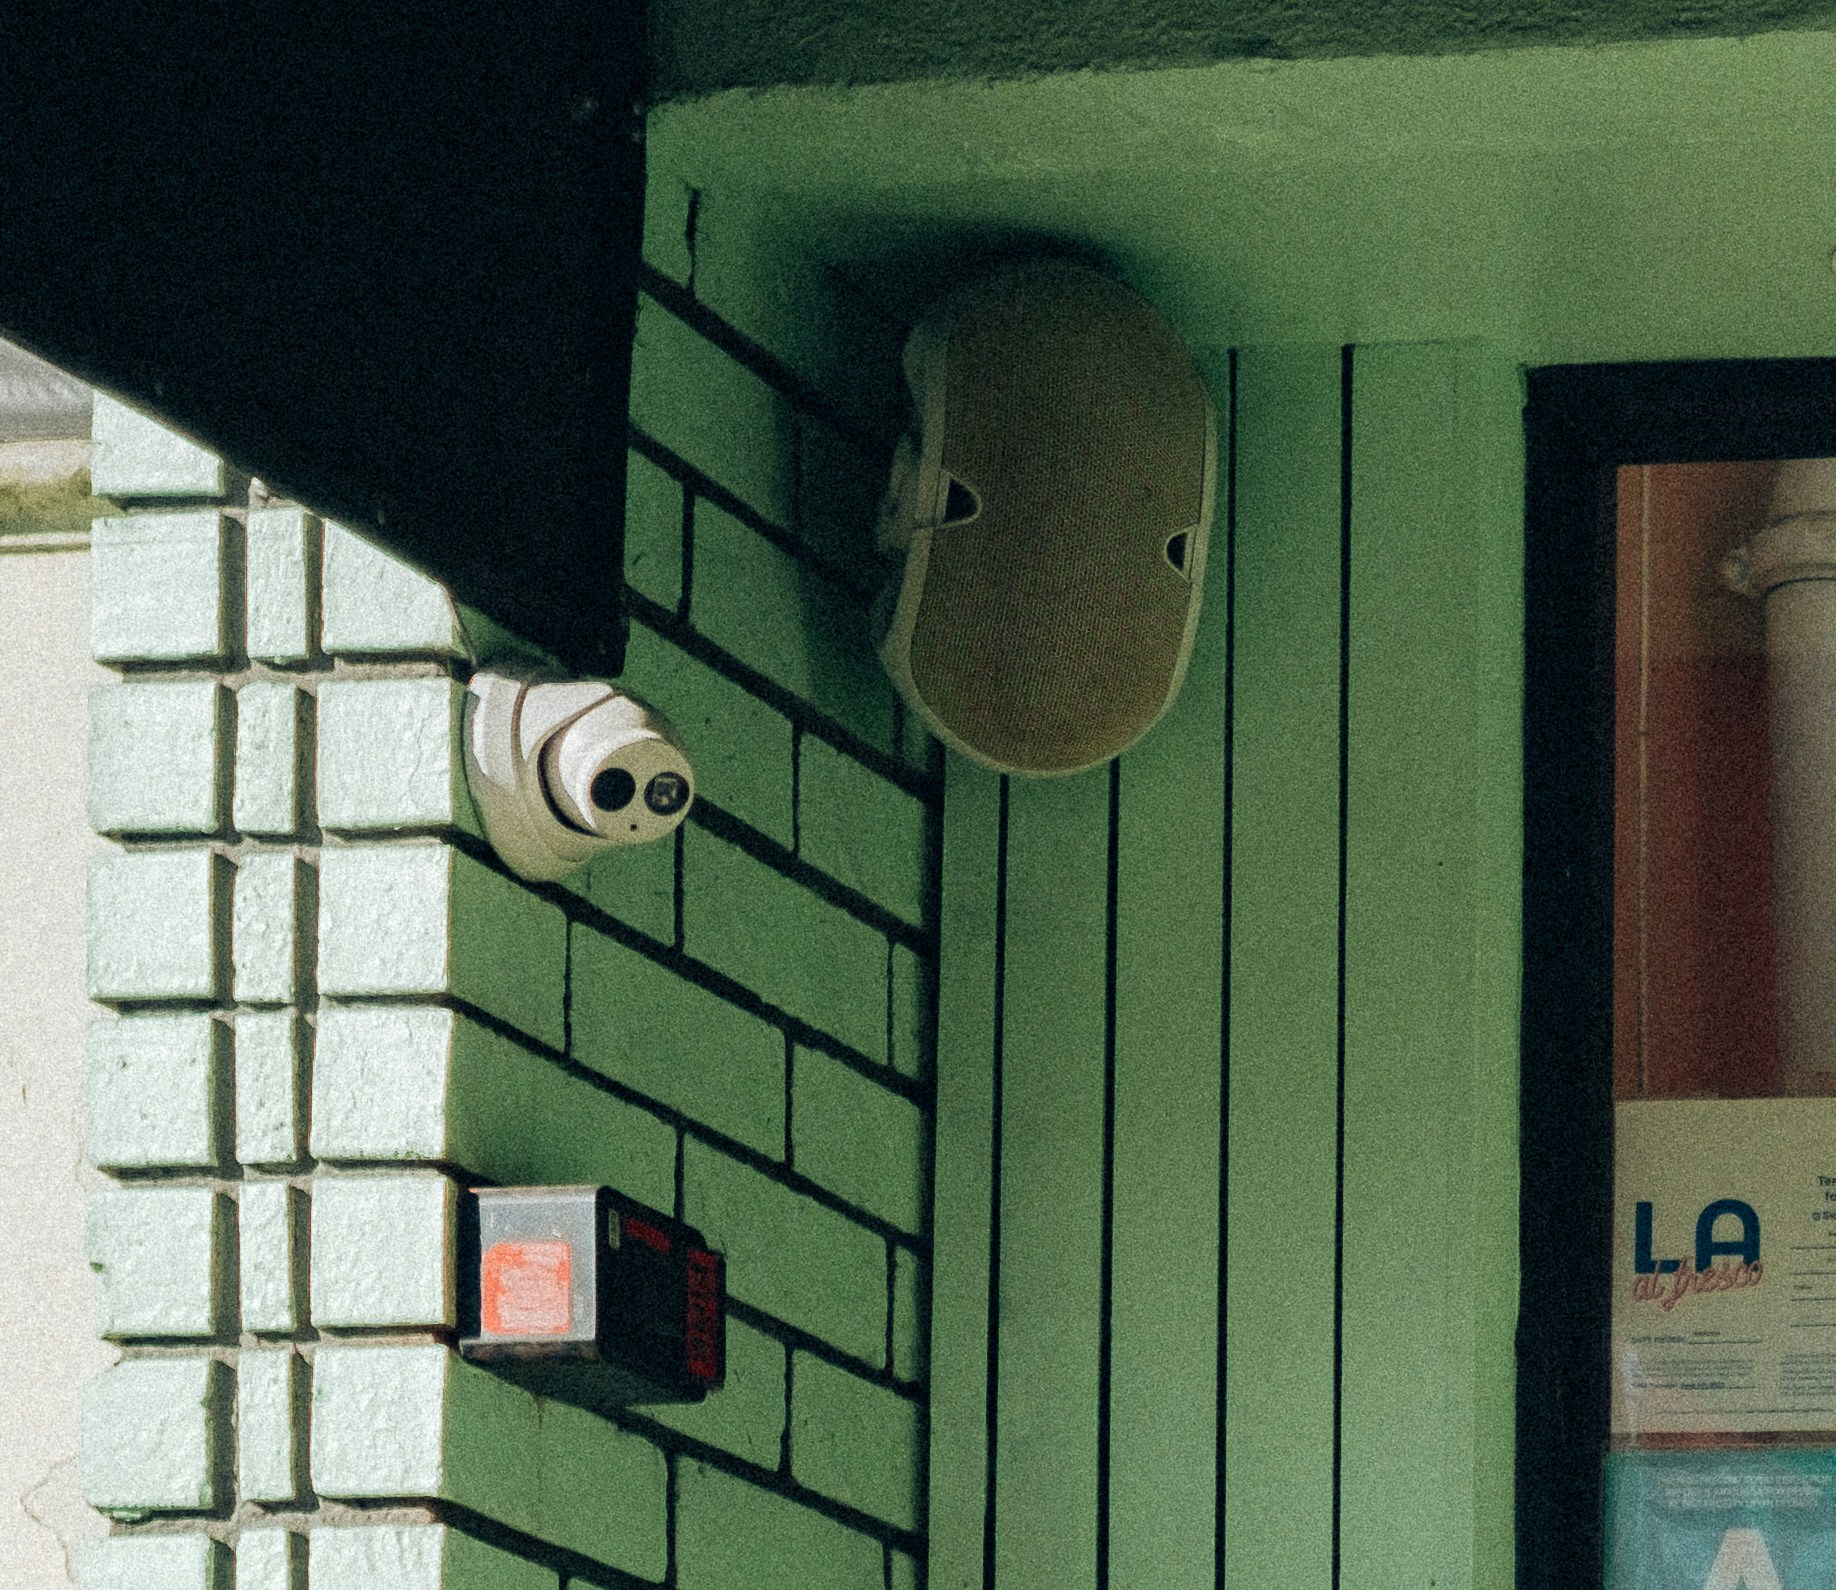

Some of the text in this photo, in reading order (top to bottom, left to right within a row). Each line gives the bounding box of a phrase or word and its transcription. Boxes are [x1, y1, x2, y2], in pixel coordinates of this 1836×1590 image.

[1634, 1199, 1761, 1275] LA
[1633, 1259, 1665, 1301] al
[1662, 1257, 1764, 1312] fresco
